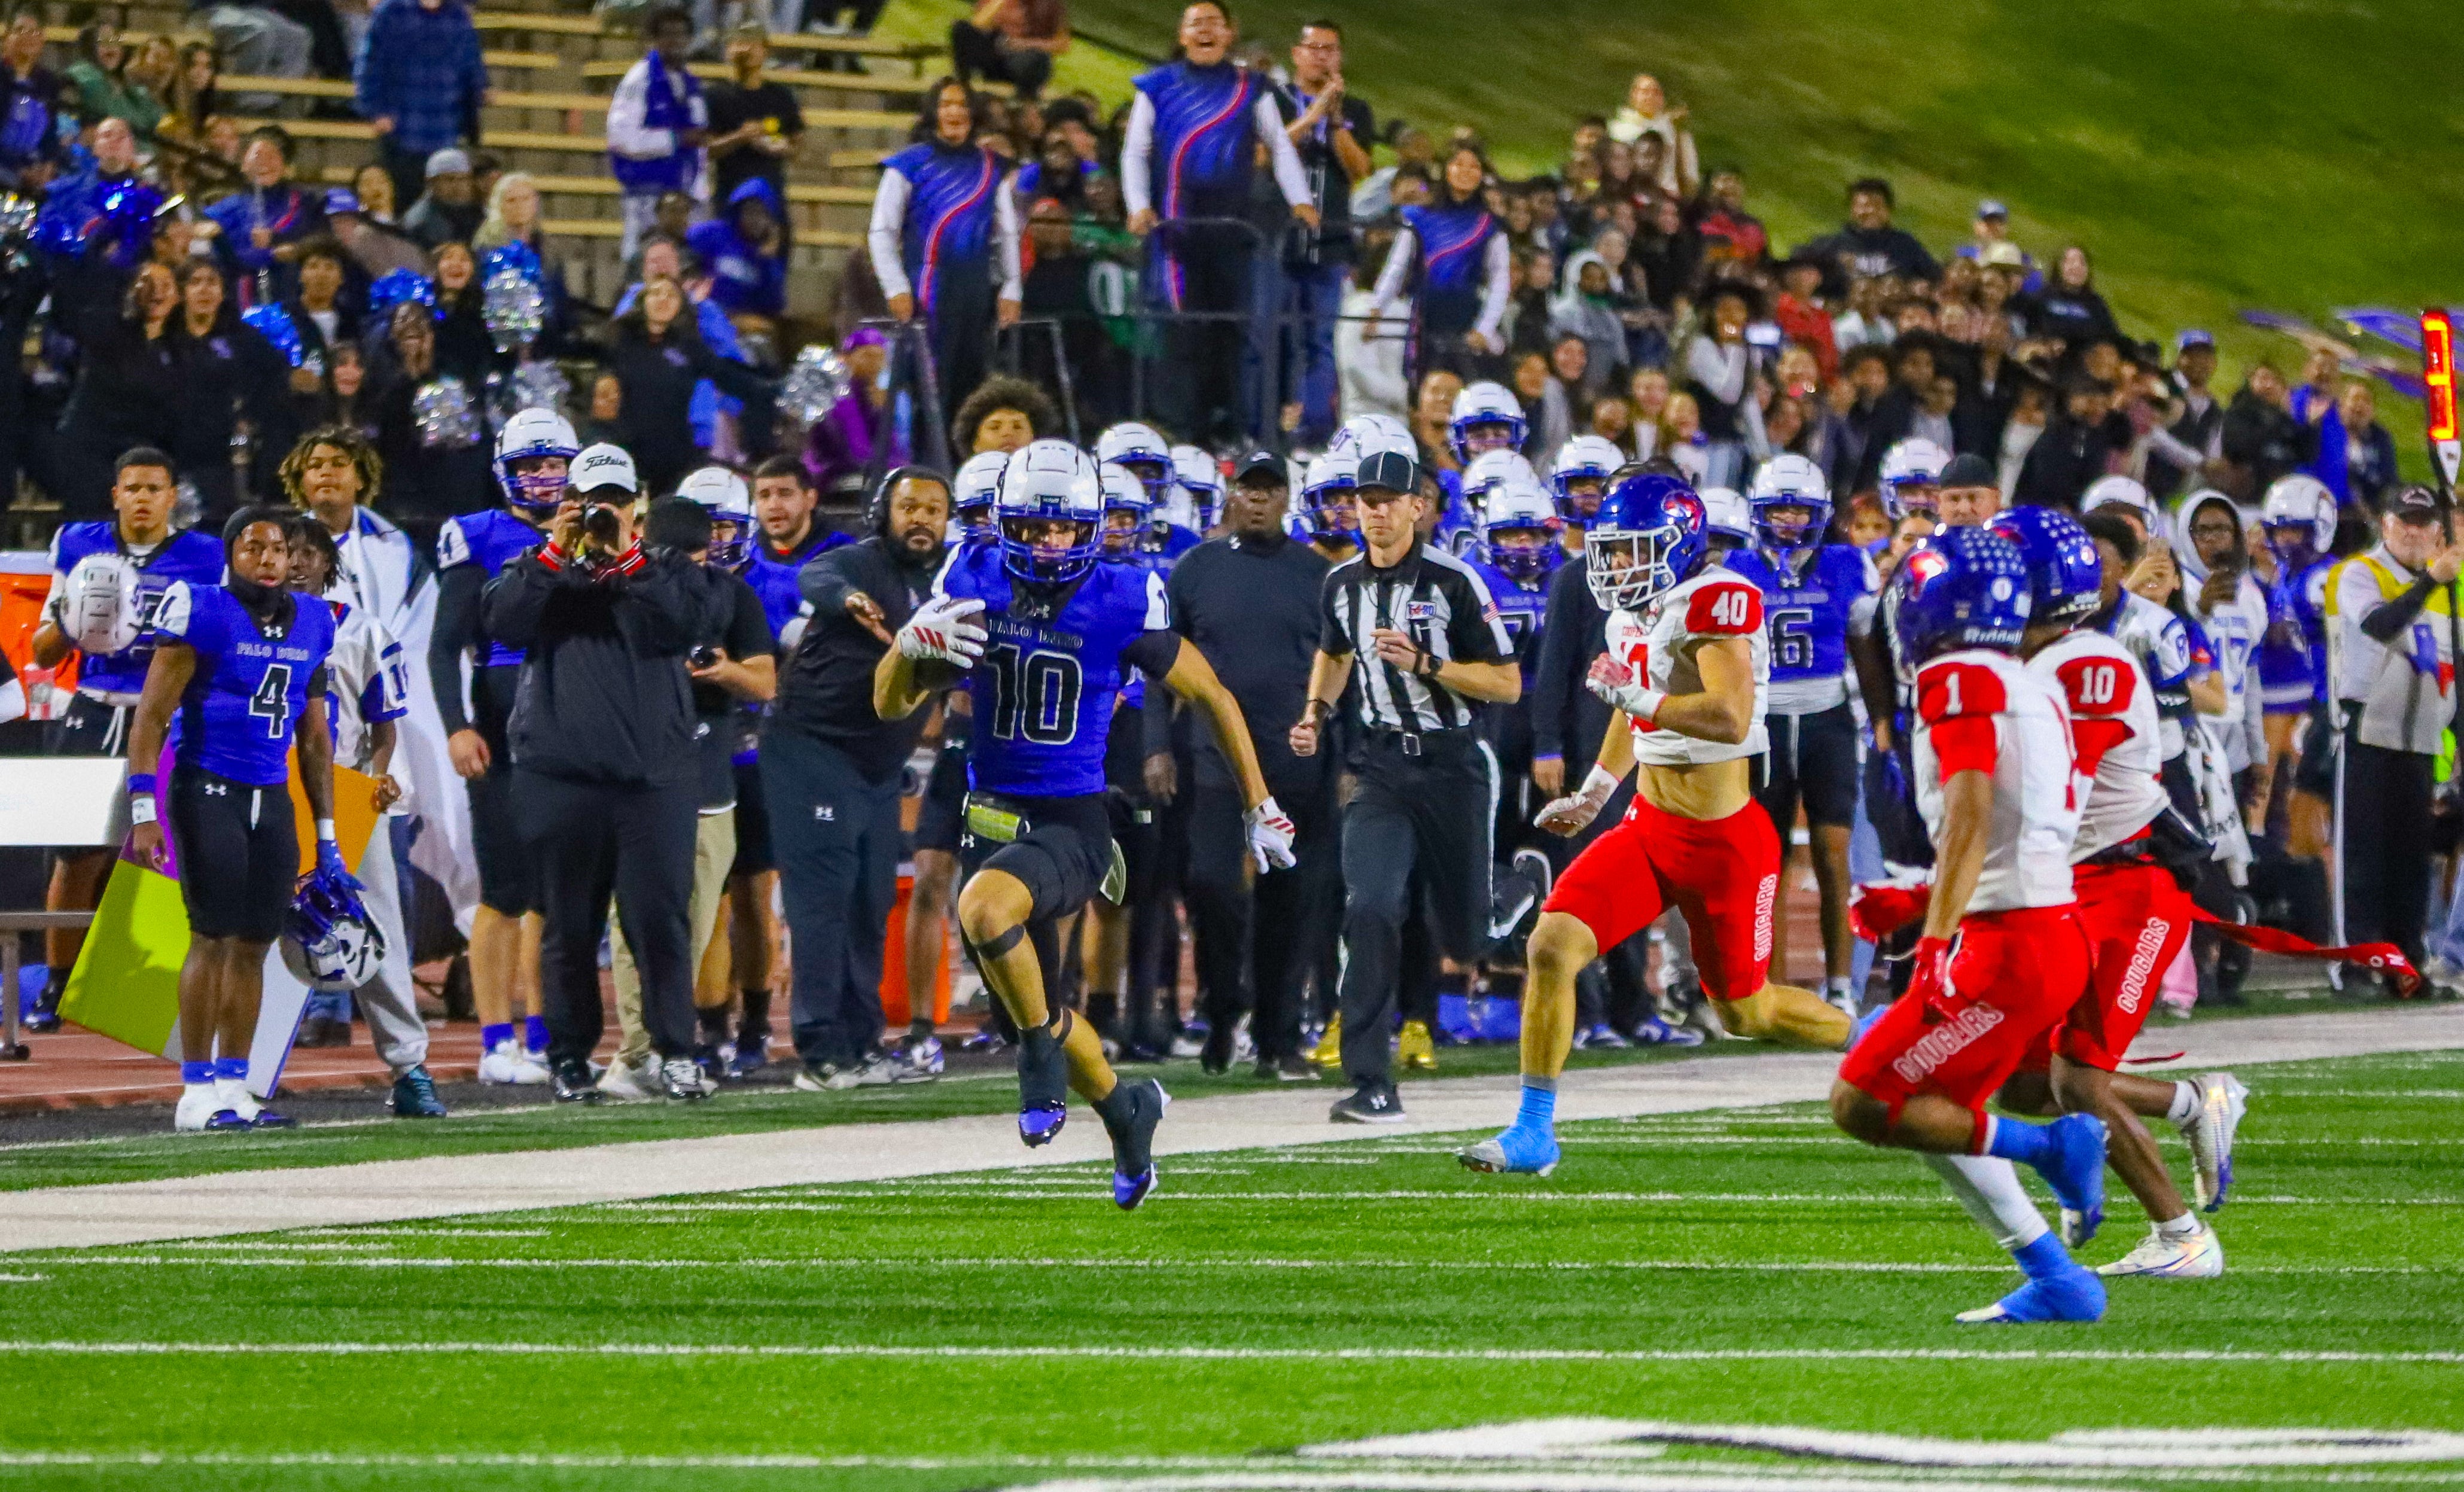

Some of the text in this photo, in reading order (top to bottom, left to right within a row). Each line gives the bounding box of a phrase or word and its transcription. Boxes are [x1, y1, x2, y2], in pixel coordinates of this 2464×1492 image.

[1711, 590, 1749, 626] 40
[1770, 608, 1813, 669] 6
[236, 642, 272, 657] PALO
[249, 663, 292, 739] 4
[983, 641, 1083, 745] 10
[1945, 671, 1963, 715] 1
[2079, 665, 2116, 705] 10
[1753, 873, 1777, 962] COUGARS
[2116, 916, 2170, 1015] COUGARS
[1892, 1001, 2005, 1084] COUGARS
